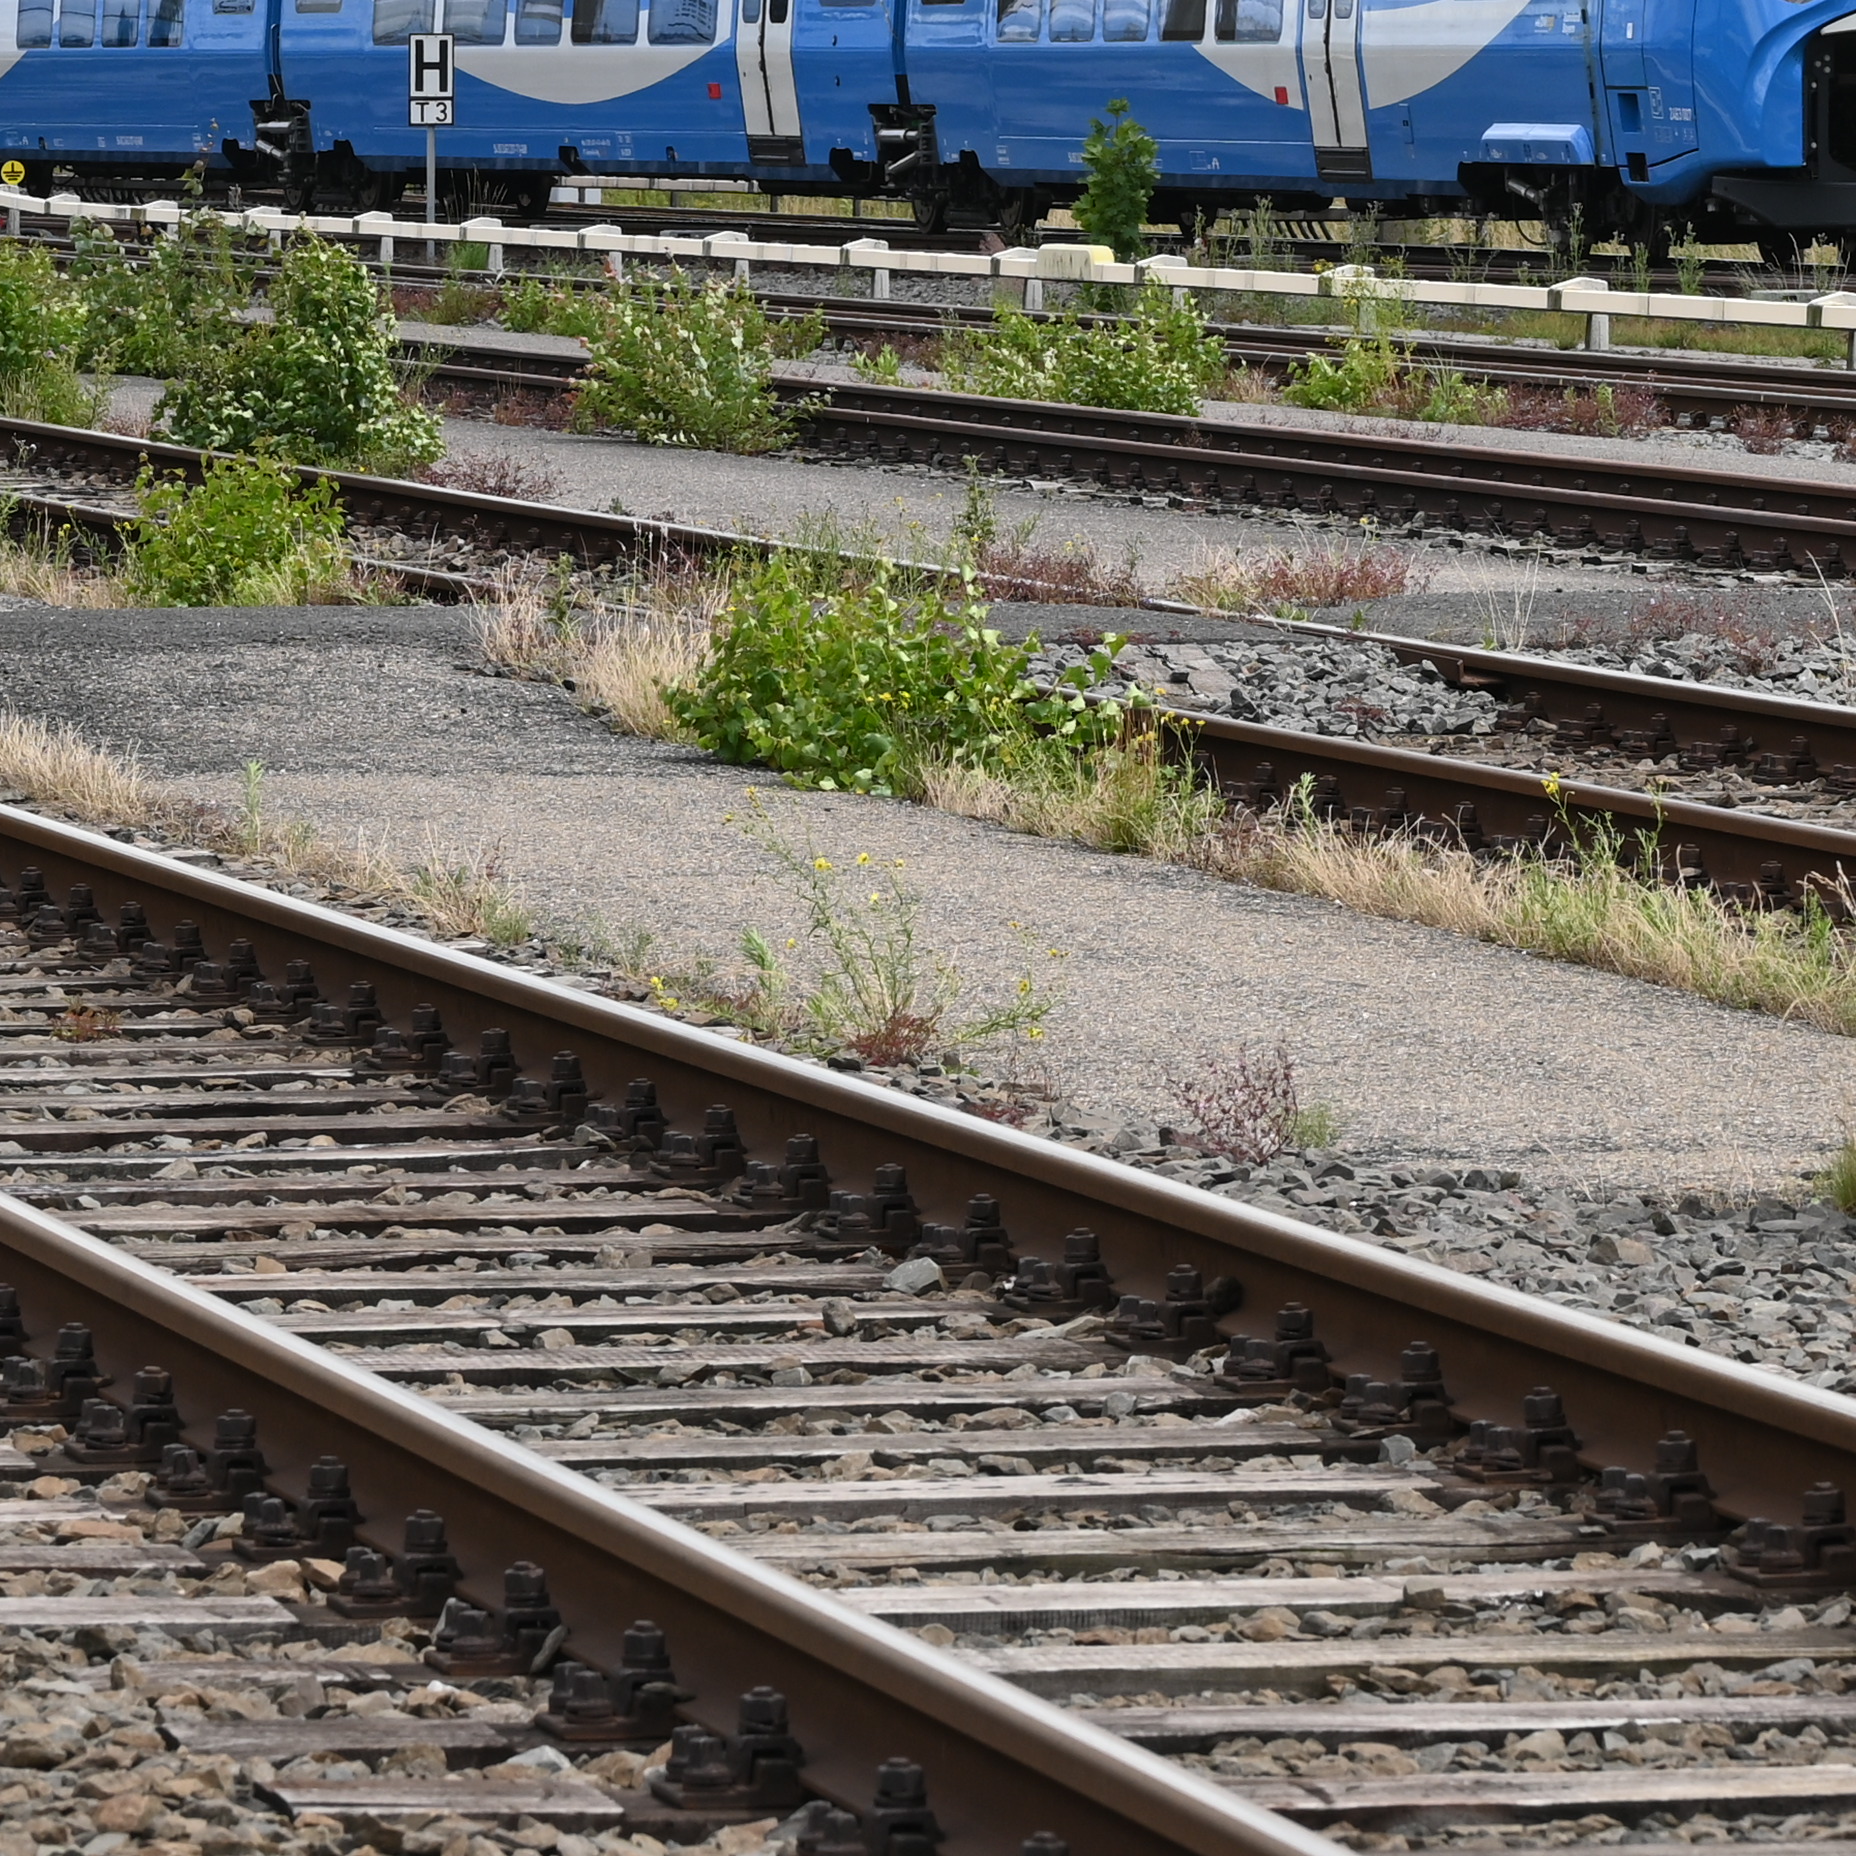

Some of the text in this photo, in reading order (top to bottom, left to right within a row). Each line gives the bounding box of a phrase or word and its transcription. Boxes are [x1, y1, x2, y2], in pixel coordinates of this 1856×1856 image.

[415, 39, 448, 92] H
[415, 102, 448, 122] T 3
